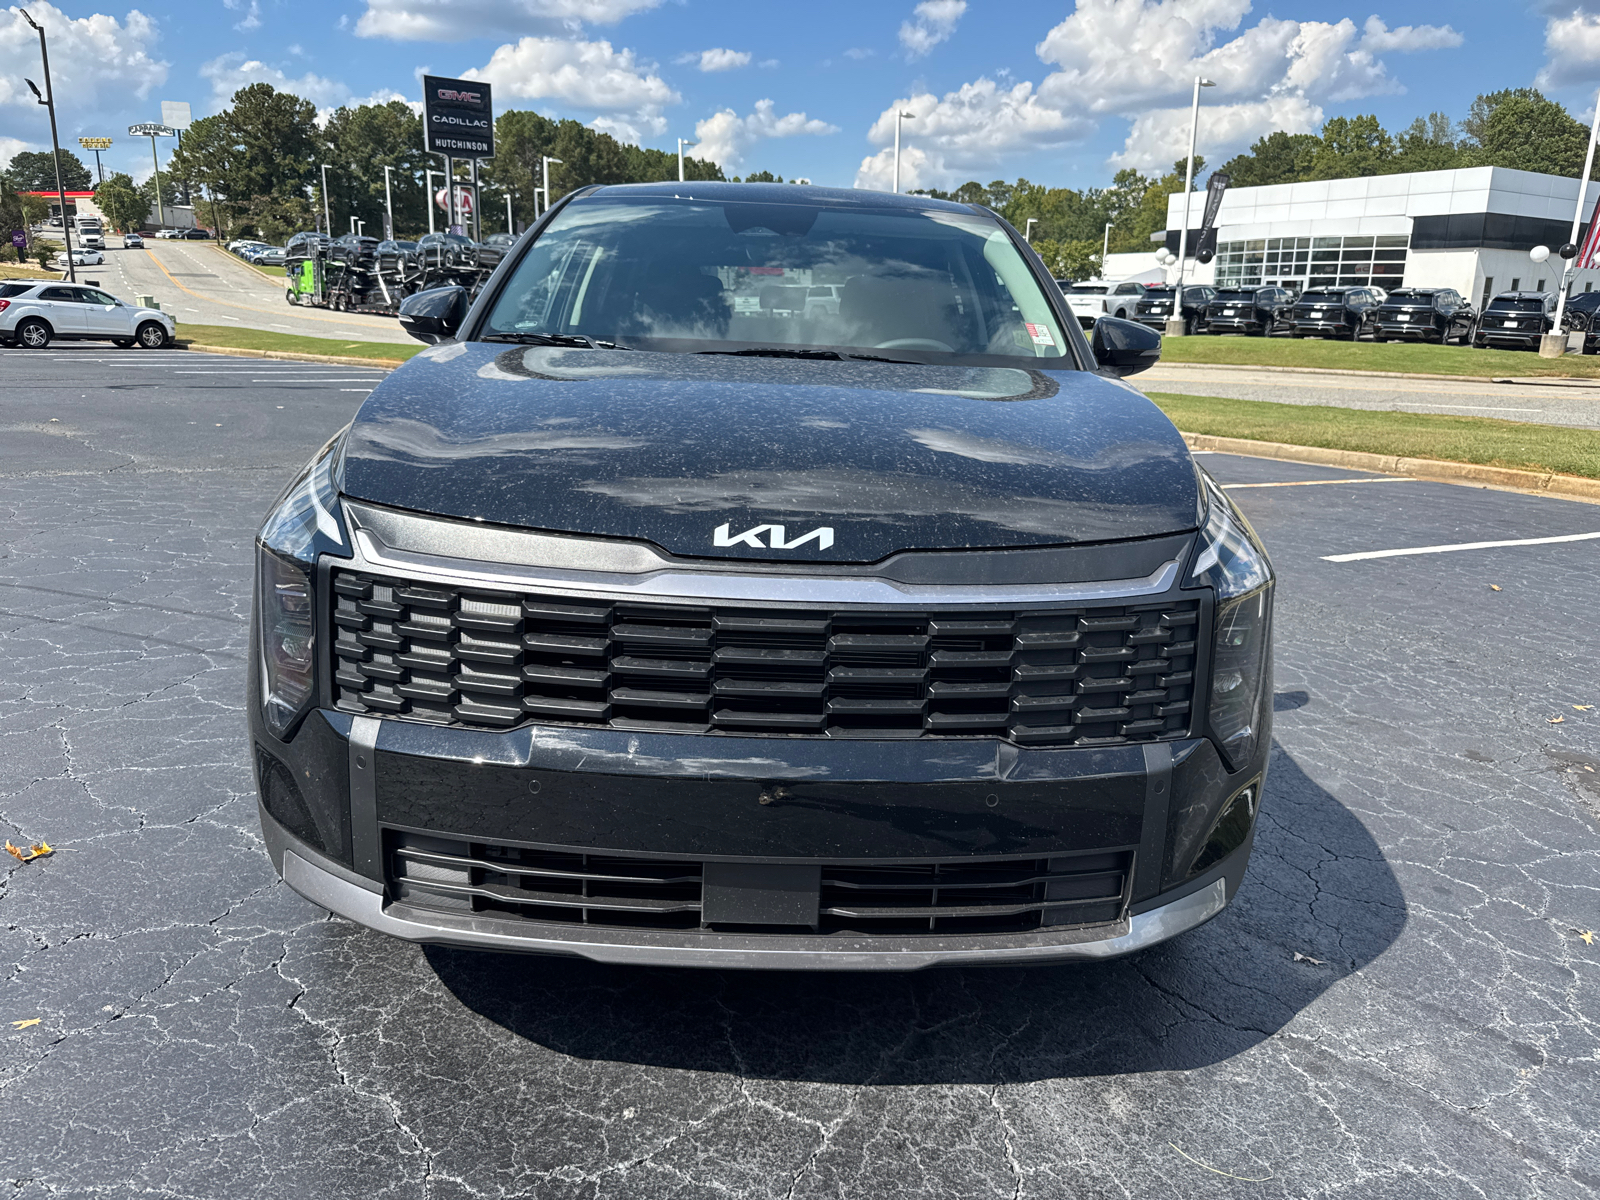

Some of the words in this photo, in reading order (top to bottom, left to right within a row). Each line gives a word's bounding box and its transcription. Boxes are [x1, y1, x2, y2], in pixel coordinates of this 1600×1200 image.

[438, 89, 481, 103] GMC
[432, 115, 489, 128] CADILLAC
[435, 138, 488, 151] HUTCHINSON
[713, 522, 834, 551] KIA
